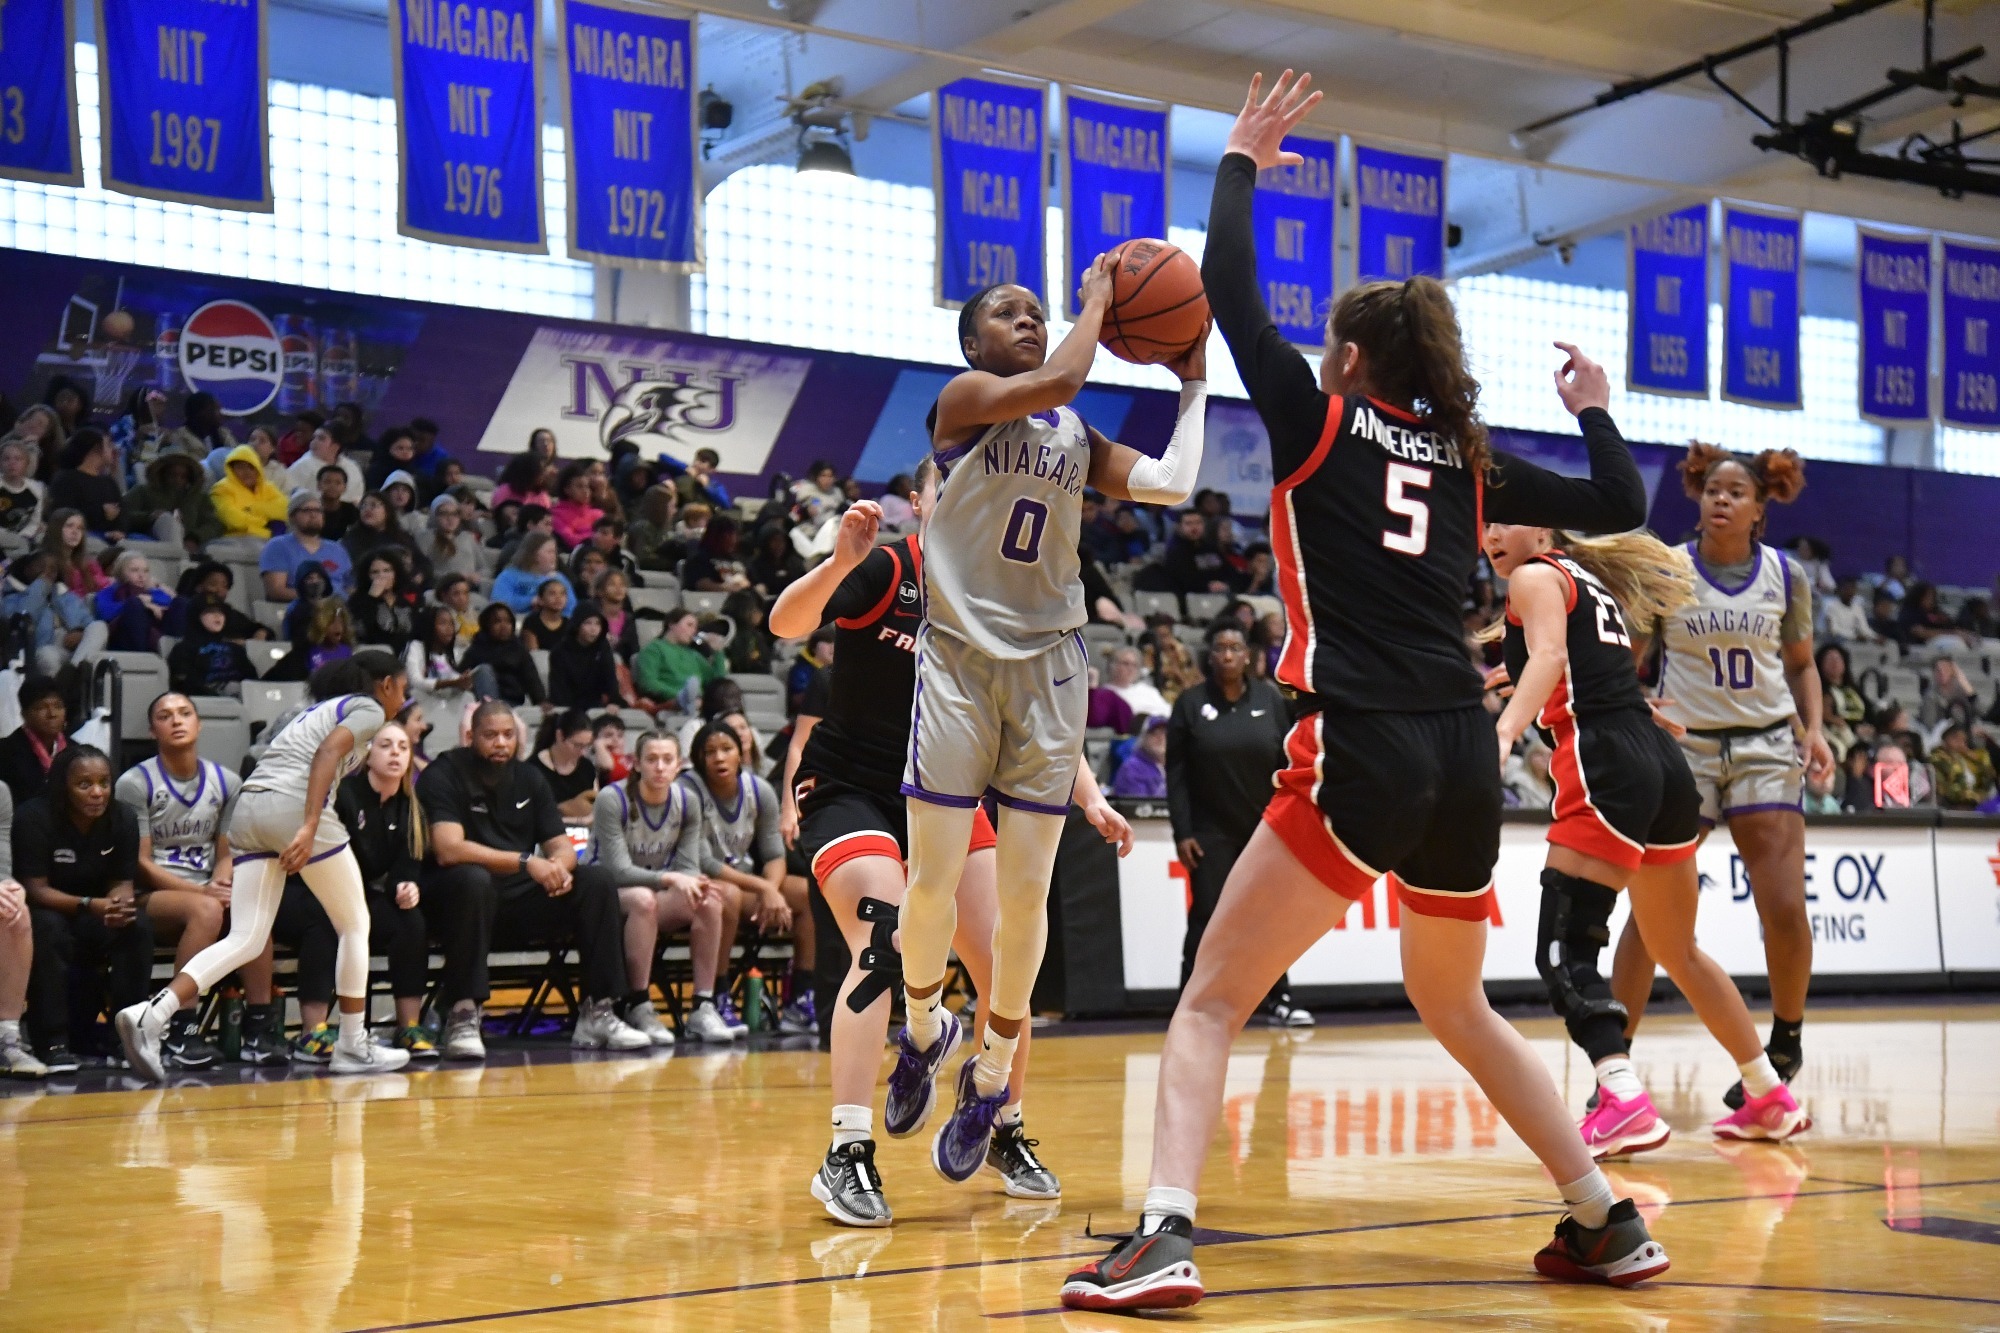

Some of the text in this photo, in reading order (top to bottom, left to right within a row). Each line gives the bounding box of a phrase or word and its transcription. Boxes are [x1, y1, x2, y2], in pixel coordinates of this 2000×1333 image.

[157, 25, 207, 85] NIT
[406, 0, 529, 63] NIAGARA
[573, 24, 684, 89] NIAGARA
[448, 82, 492, 137] NIT
[613, 108, 653, 161] NIT
[944, 94, 1037, 153] NIAGARA
[150, 110, 222, 173] 1987
[1073, 116, 1161, 173] NIAGARA
[443, 161, 503, 219] 1976
[607, 185, 666, 240] 1972
[962, 169, 1020, 221] NCAA
[1101, 192, 1133, 237] NIT
[1361, 164, 1440, 217] NIAGARA
[1275, 217, 1305, 263] NIT
[186, 341, 277, 373] PEPSI
[1350, 407, 1463, 469] ANDERSEN
[999, 496, 1049, 566] 0
[1382, 460, 1432, 557] 5
[1706, 646, 1756, 691] 10
[1730, 853, 1888, 902] BE OX
